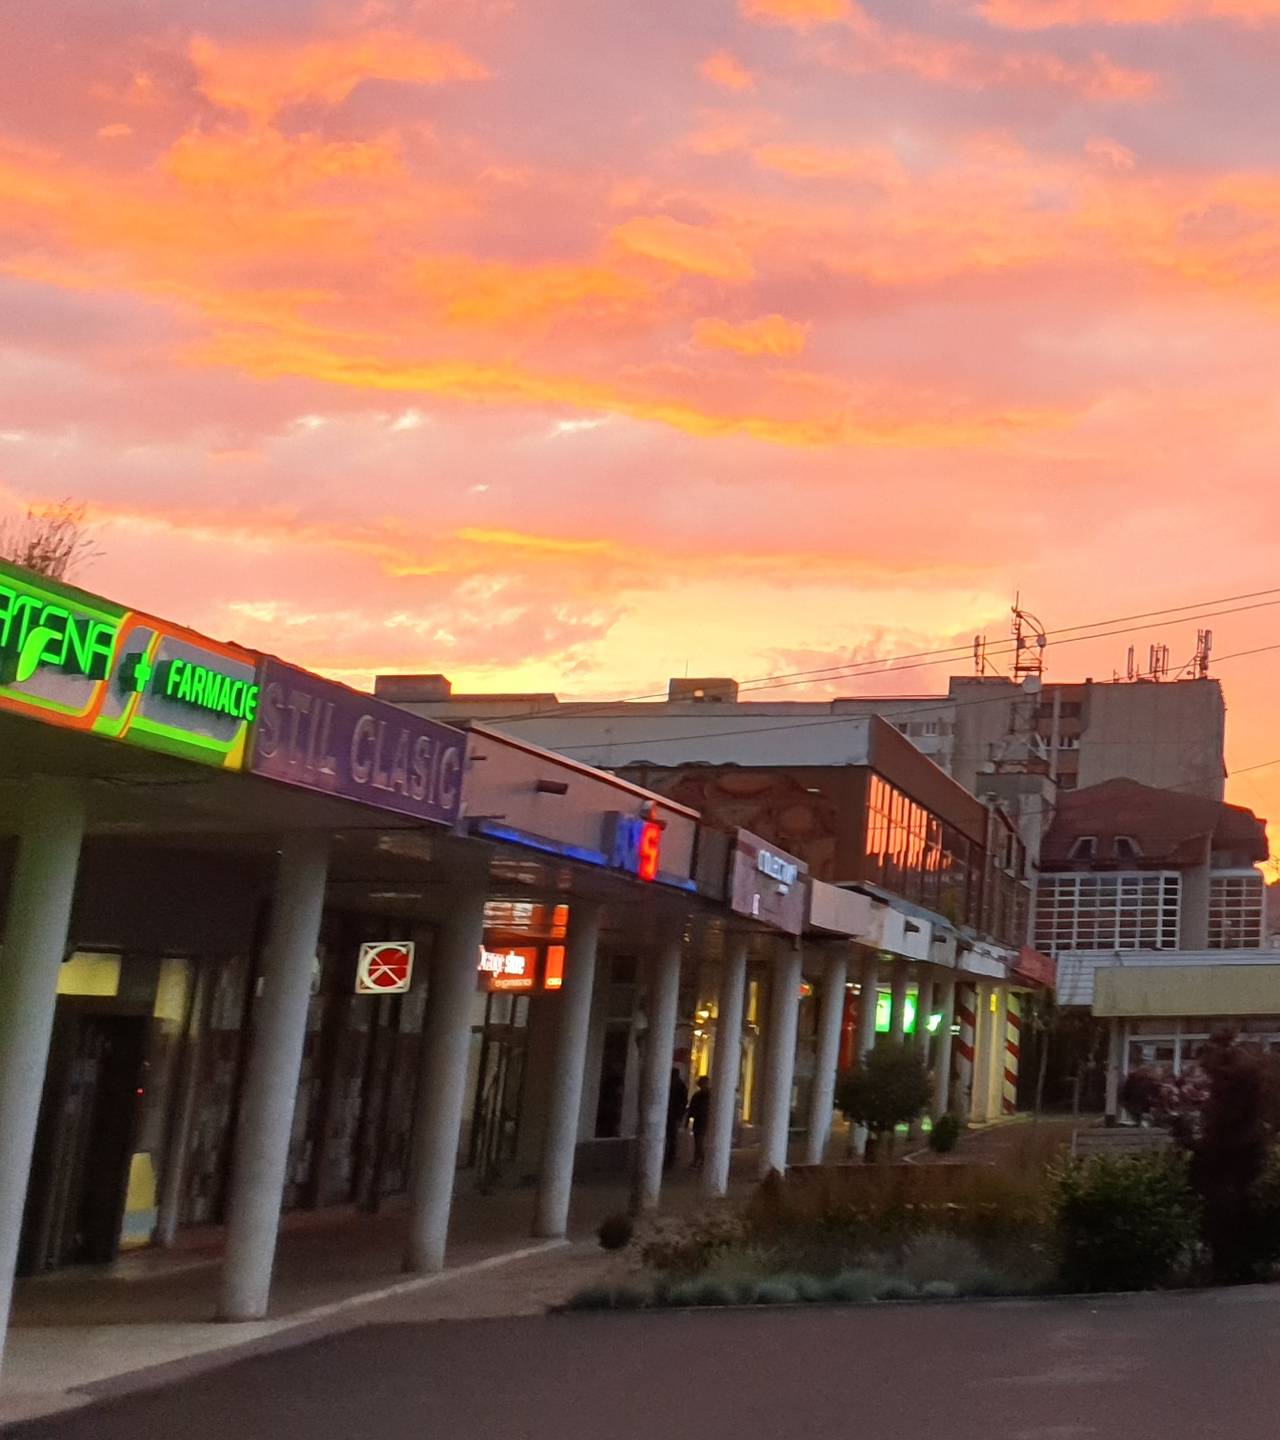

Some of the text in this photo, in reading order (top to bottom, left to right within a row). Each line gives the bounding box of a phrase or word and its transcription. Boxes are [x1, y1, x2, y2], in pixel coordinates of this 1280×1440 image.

[166, 658, 260, 722] FARMACIE
[258, 681, 460, 809] STIL CLASIC
